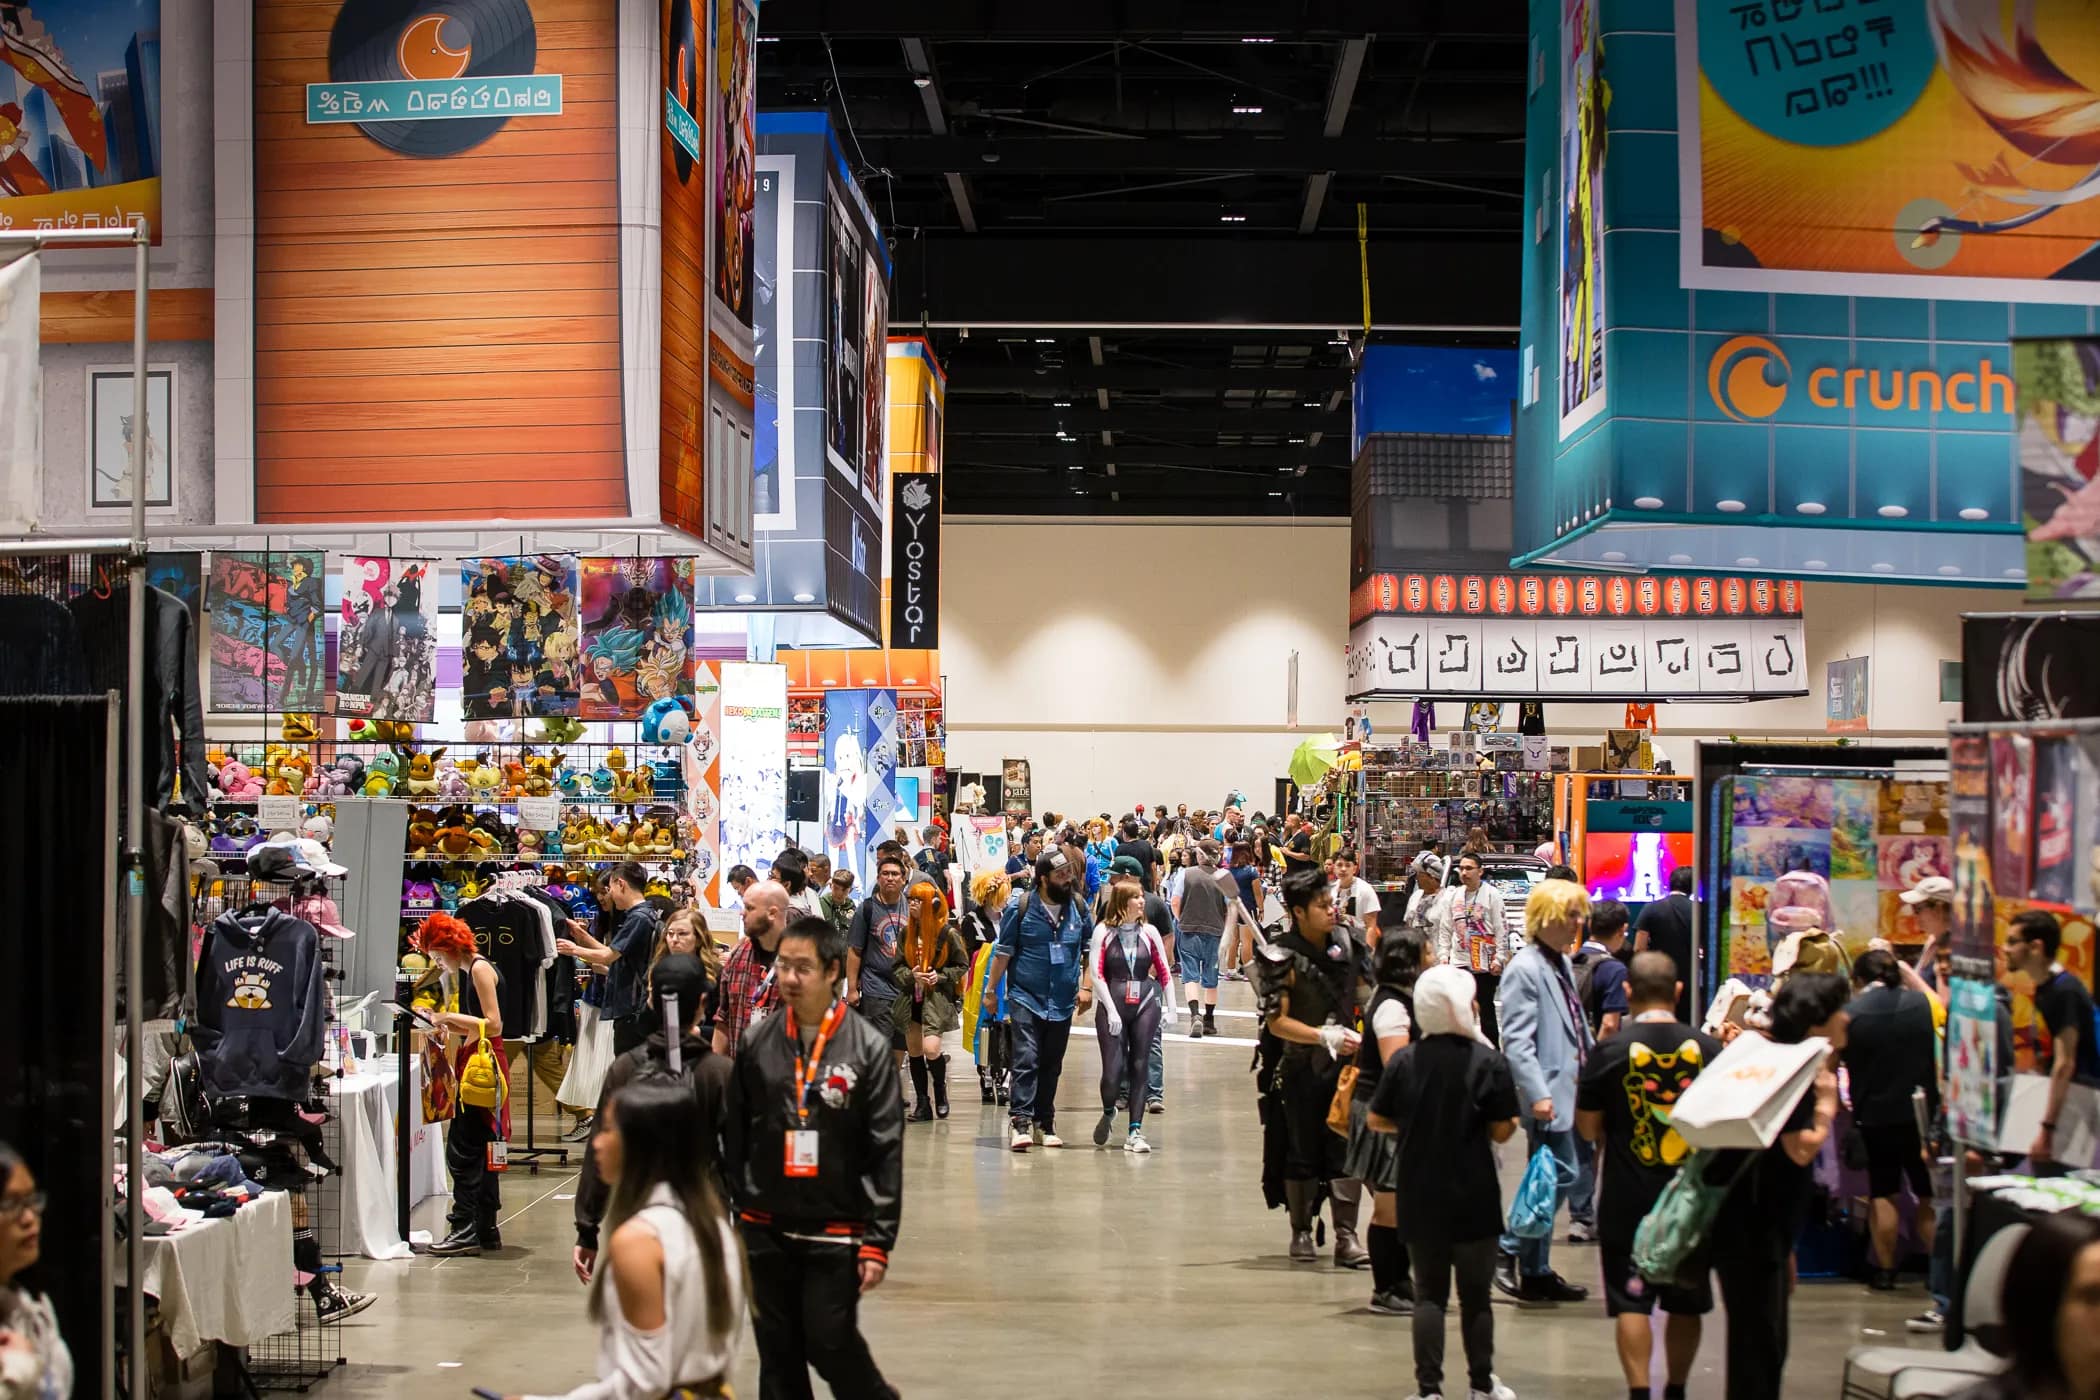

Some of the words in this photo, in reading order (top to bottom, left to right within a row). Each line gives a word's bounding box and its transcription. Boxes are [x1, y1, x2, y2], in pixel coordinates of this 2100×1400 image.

[1808, 359, 2015, 414] crunch
[224, 956, 245, 973] LIFE
[246, 955, 257, 968] IS
[257, 957, 284, 975] RUFF
